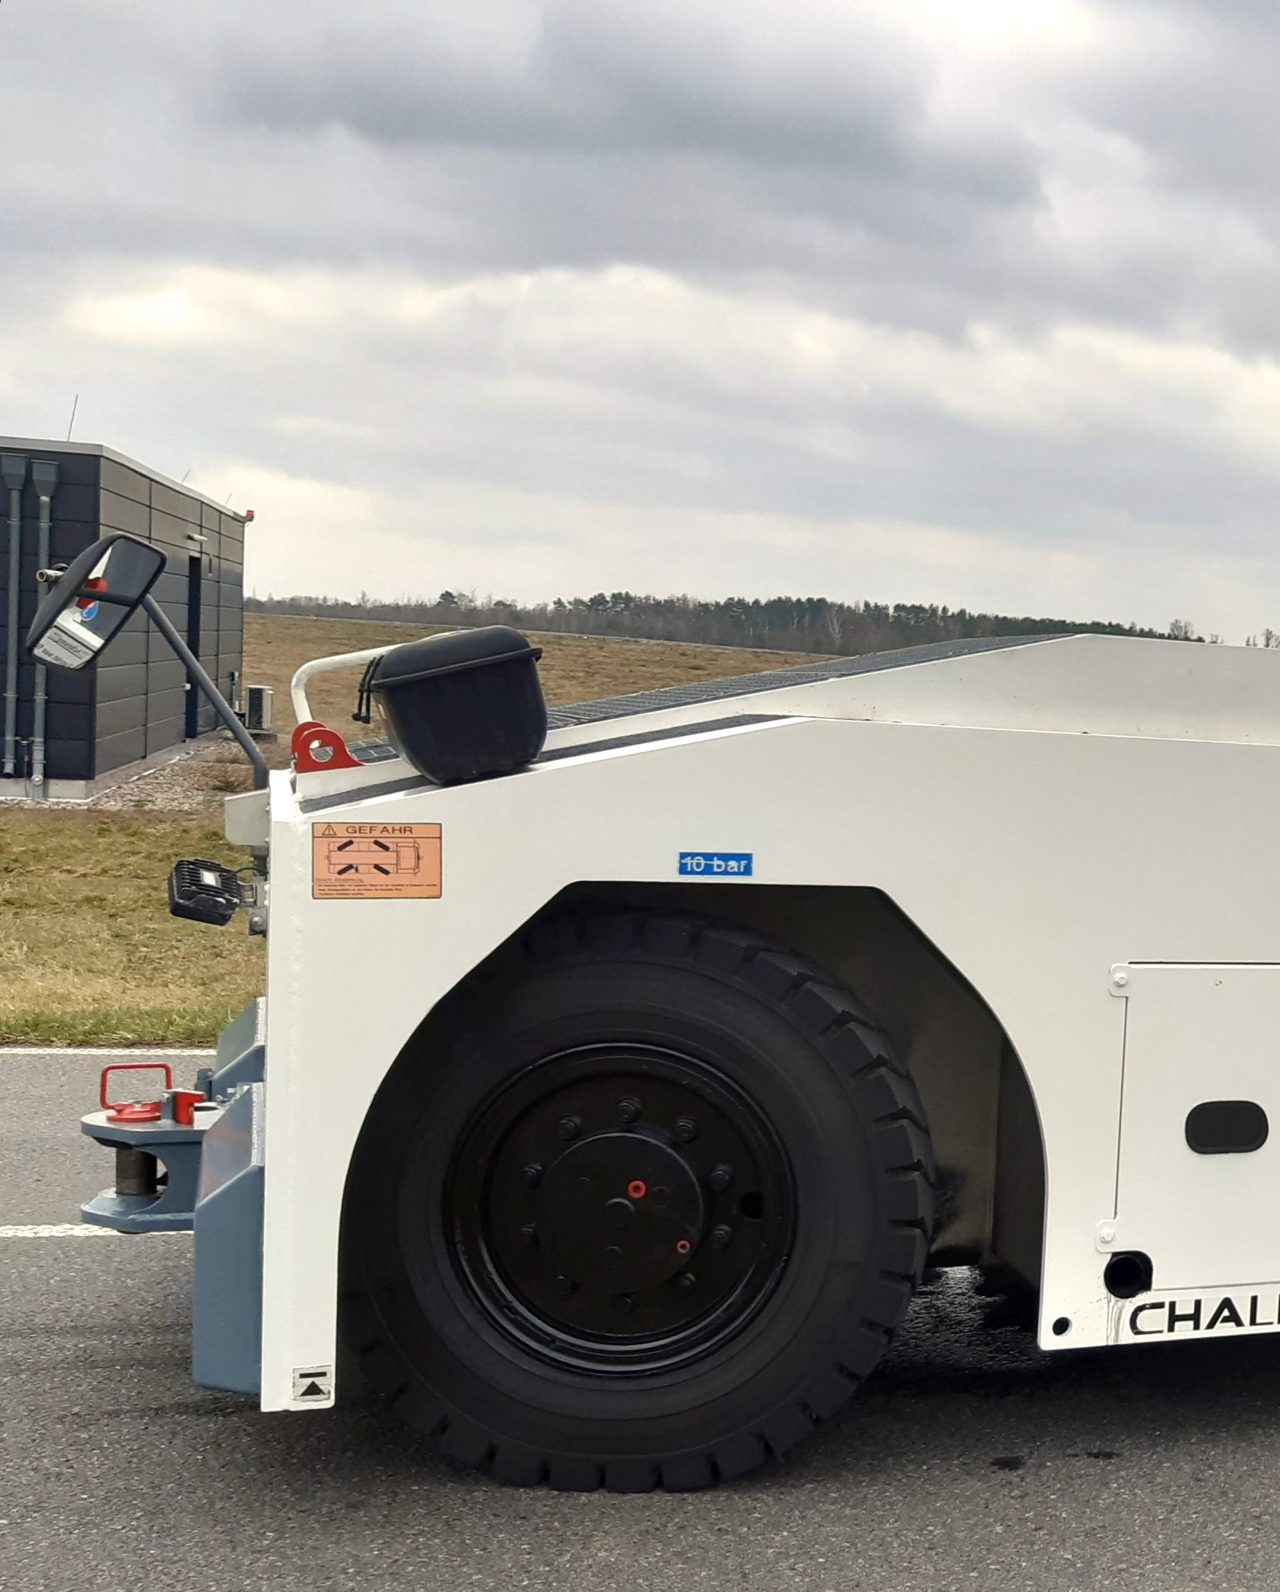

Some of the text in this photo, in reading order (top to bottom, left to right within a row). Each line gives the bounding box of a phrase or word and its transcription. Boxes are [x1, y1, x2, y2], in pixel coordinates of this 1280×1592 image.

[345, 825, 413, 835] GEFAHR
[683, 856, 748, 872] 10 bar
